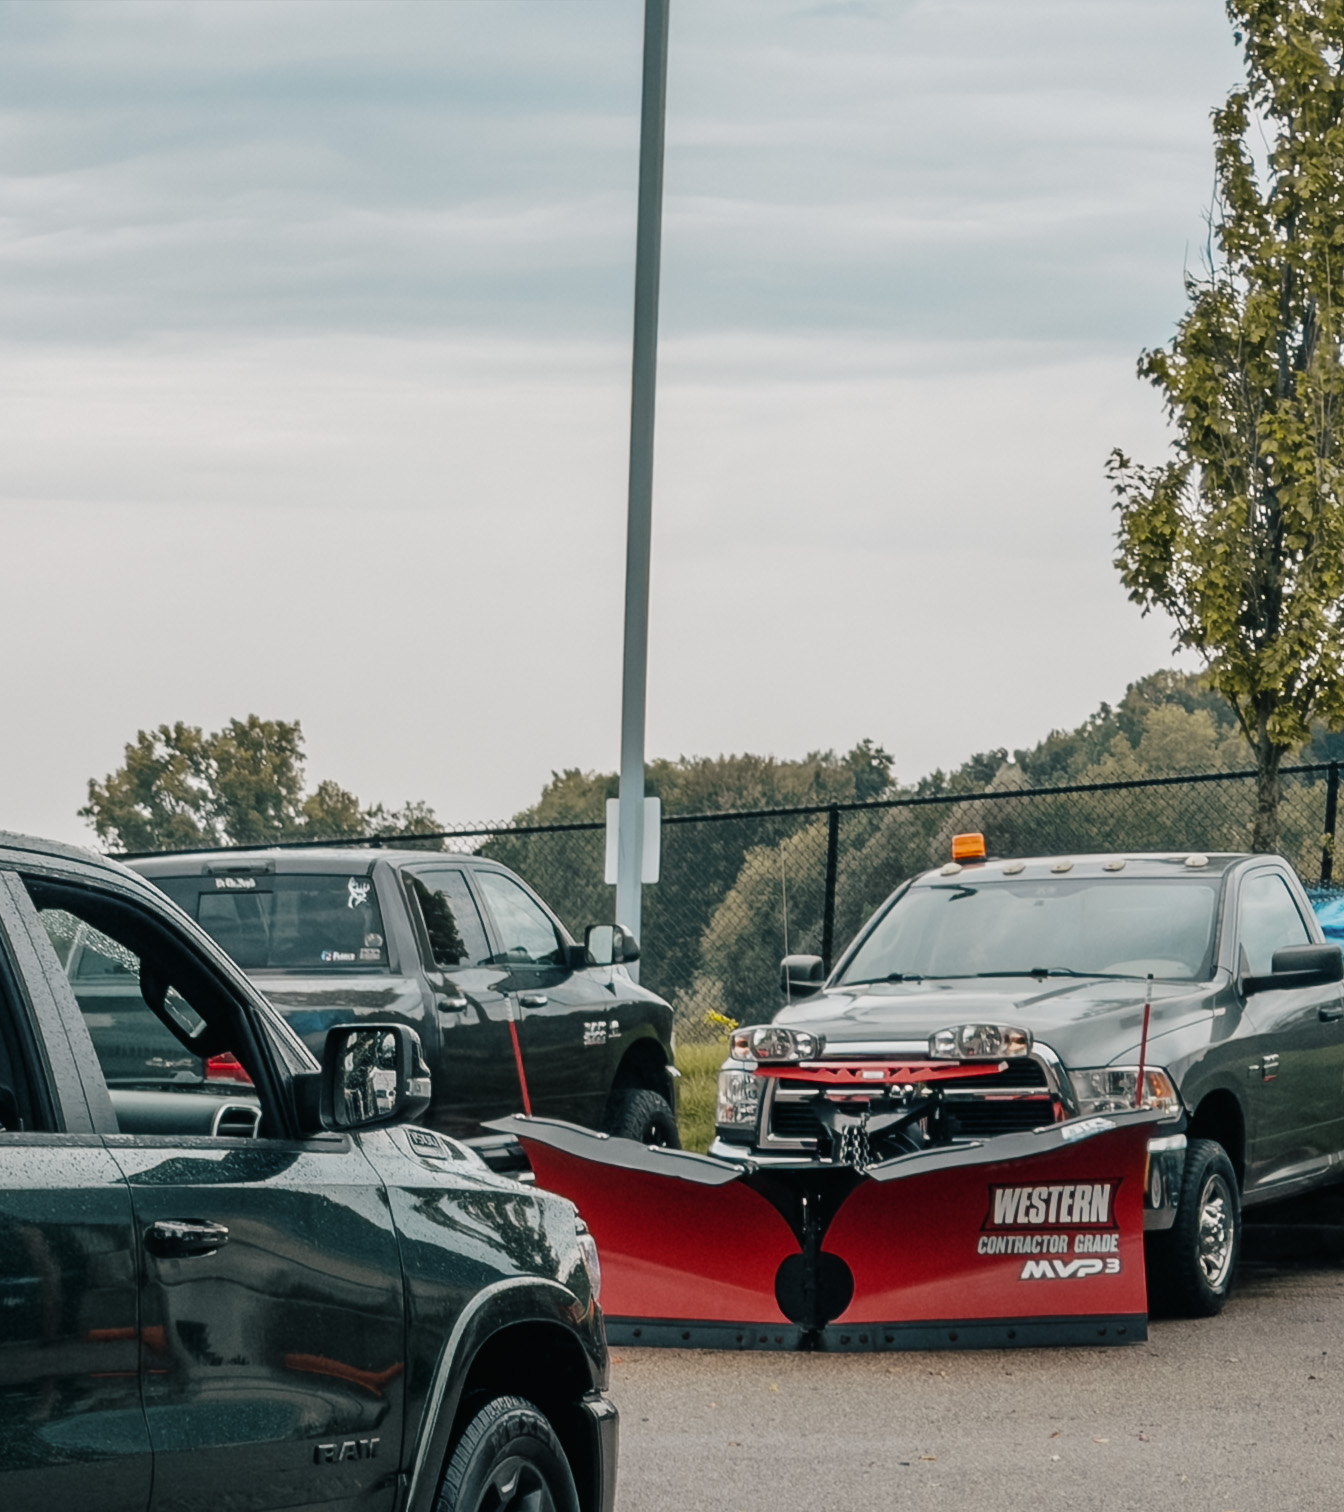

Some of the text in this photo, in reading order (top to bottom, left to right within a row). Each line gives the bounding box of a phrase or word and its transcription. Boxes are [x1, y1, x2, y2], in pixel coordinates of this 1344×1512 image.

[993, 1184, 1111, 1225] WESTERN
[977, 1233, 1120, 1255] CONTRACTOR GRADE
[313, 1437, 381, 1465] RAM
